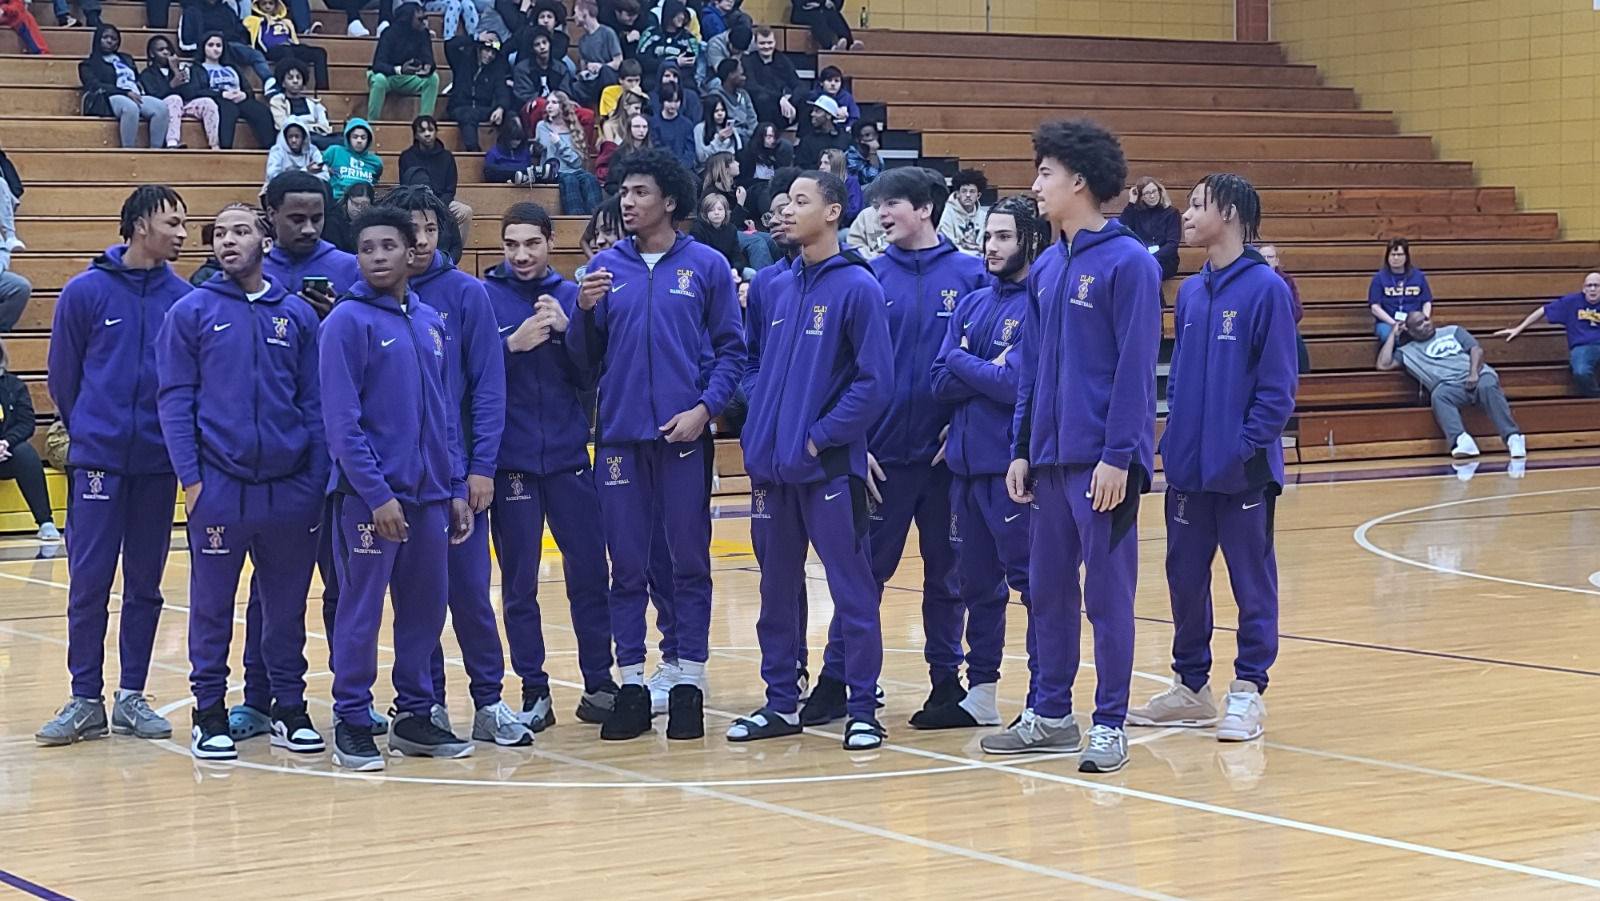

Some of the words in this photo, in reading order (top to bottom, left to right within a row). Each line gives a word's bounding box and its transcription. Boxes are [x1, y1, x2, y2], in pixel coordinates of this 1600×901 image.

[340, 165, 374, 179] PRIME
[677, 269, 694, 277] CLAY
[1080, 275, 1095, 284] CLAY
[941, 289, 958, 297] CLAY
[1222, 310, 1238, 318] CLAY
[272, 316, 289, 326] CLAY
[1004, 318, 1019, 327] CLAY
[606, 456, 623, 464] CLAY
[87, 471, 106, 479] CLAY
[206, 526, 225, 534] CLAY
